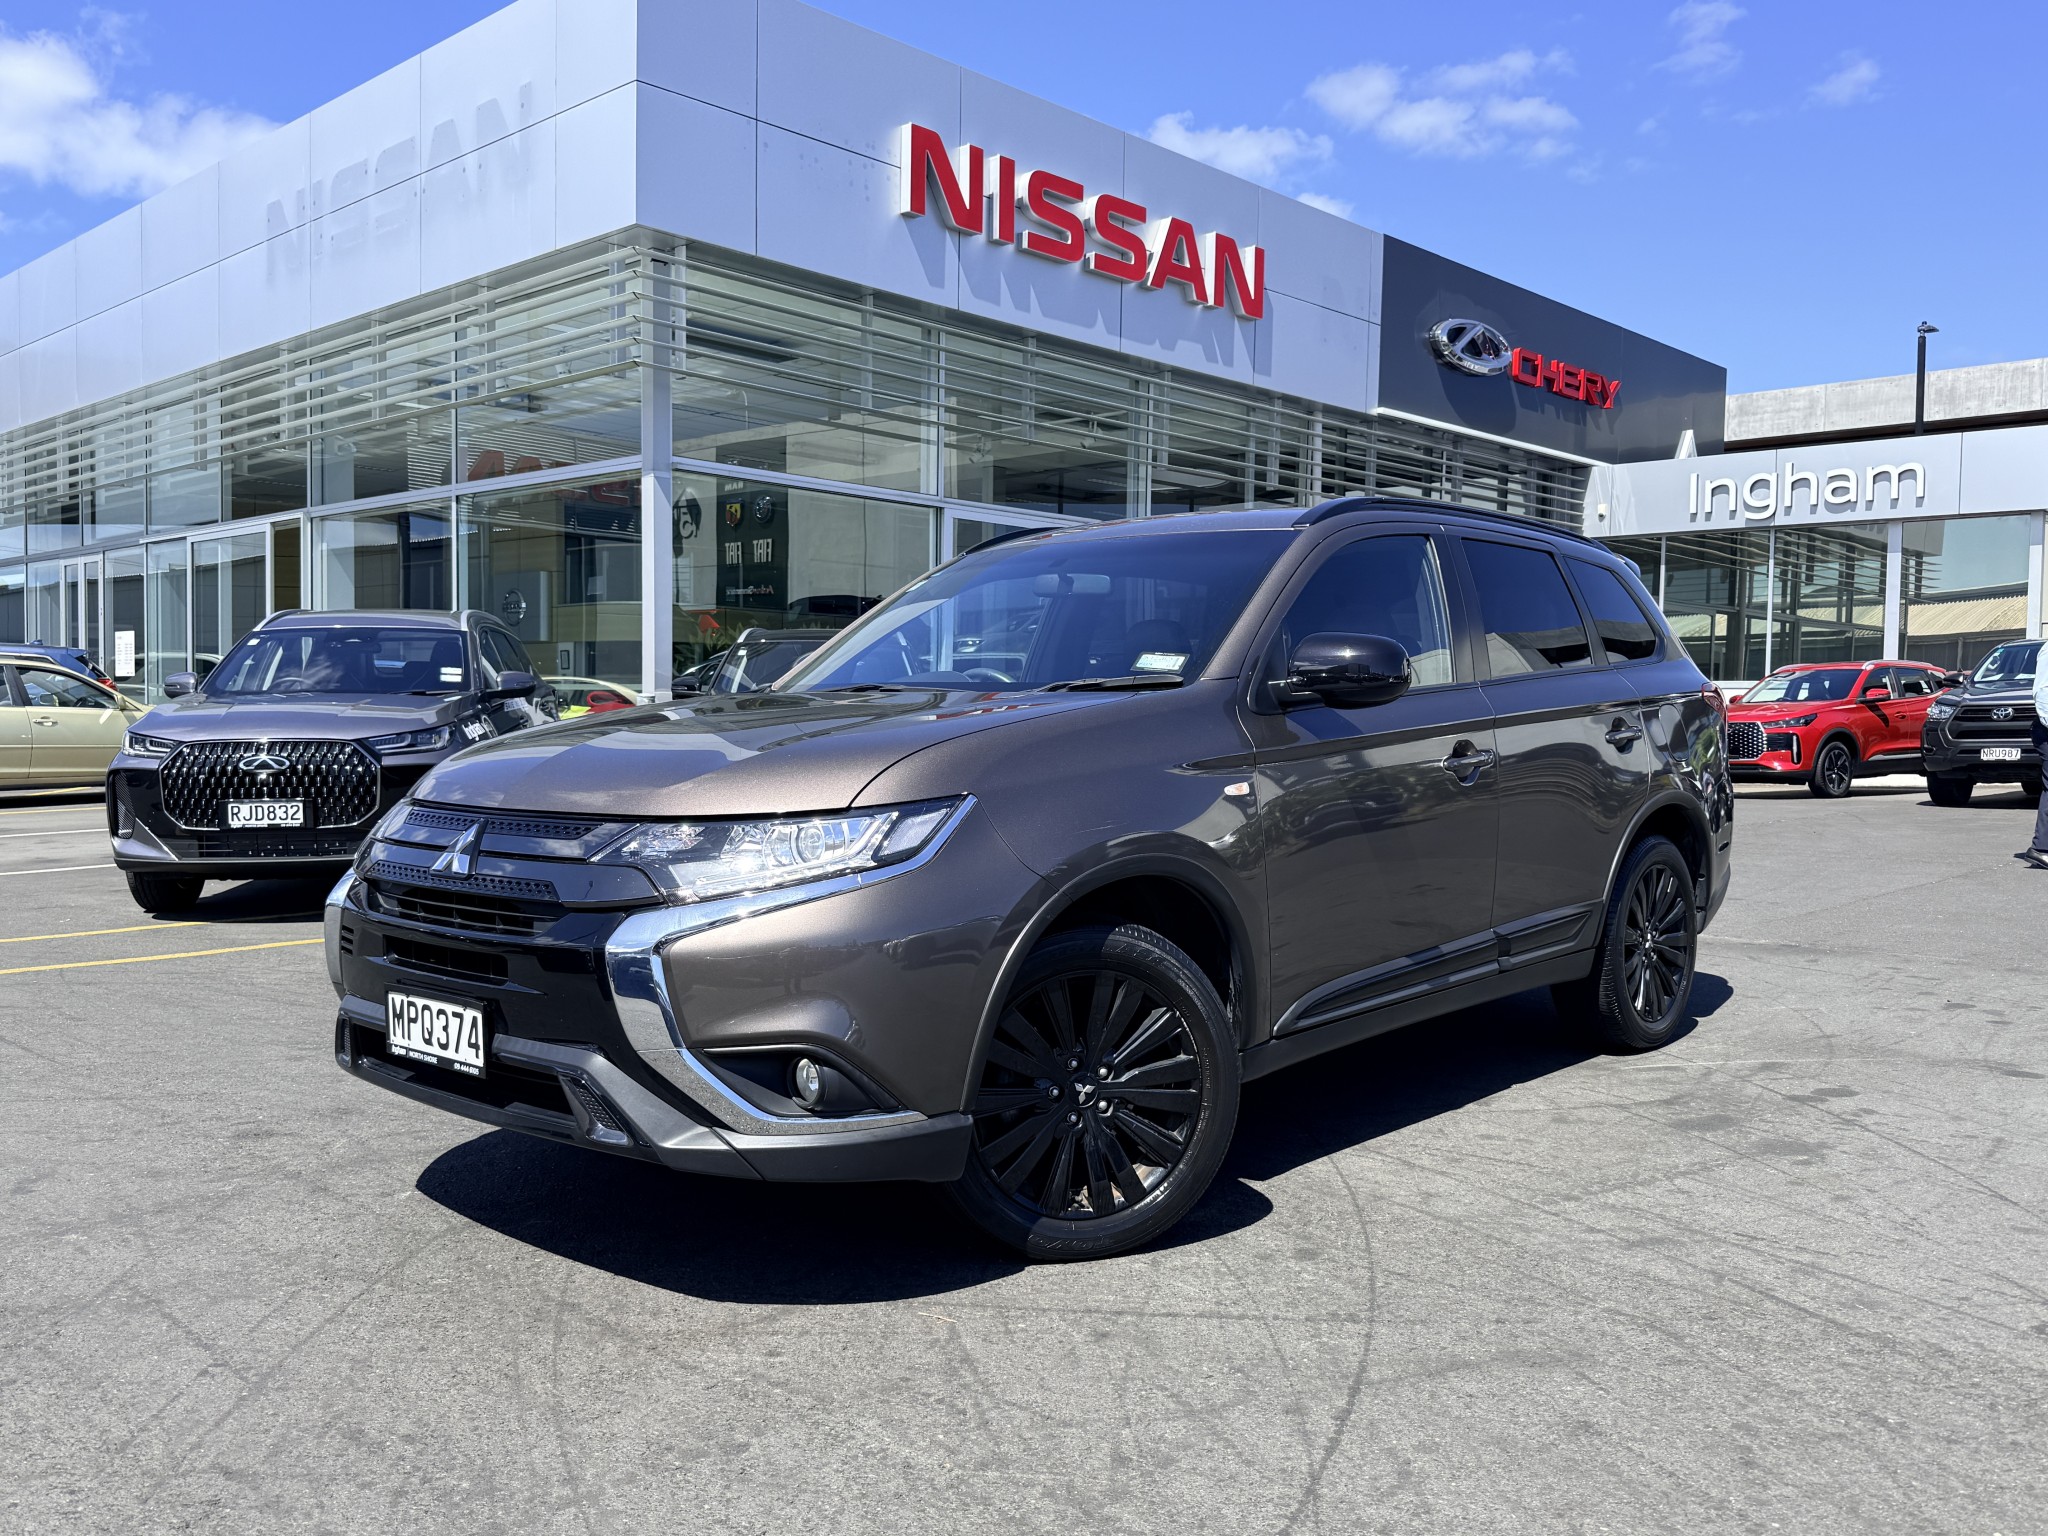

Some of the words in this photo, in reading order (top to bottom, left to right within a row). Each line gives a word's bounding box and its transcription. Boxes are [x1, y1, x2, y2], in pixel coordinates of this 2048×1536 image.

[901, 122, 1265, 320] NISSAN
[1512, 348, 1621, 409] CHERY
[1689, 462, 1925, 520] Ingham
[1982, 749, 2019, 758] NRU987
[230, 804, 301, 822] RJD832
[391, 996, 480, 1060] MPQ374
